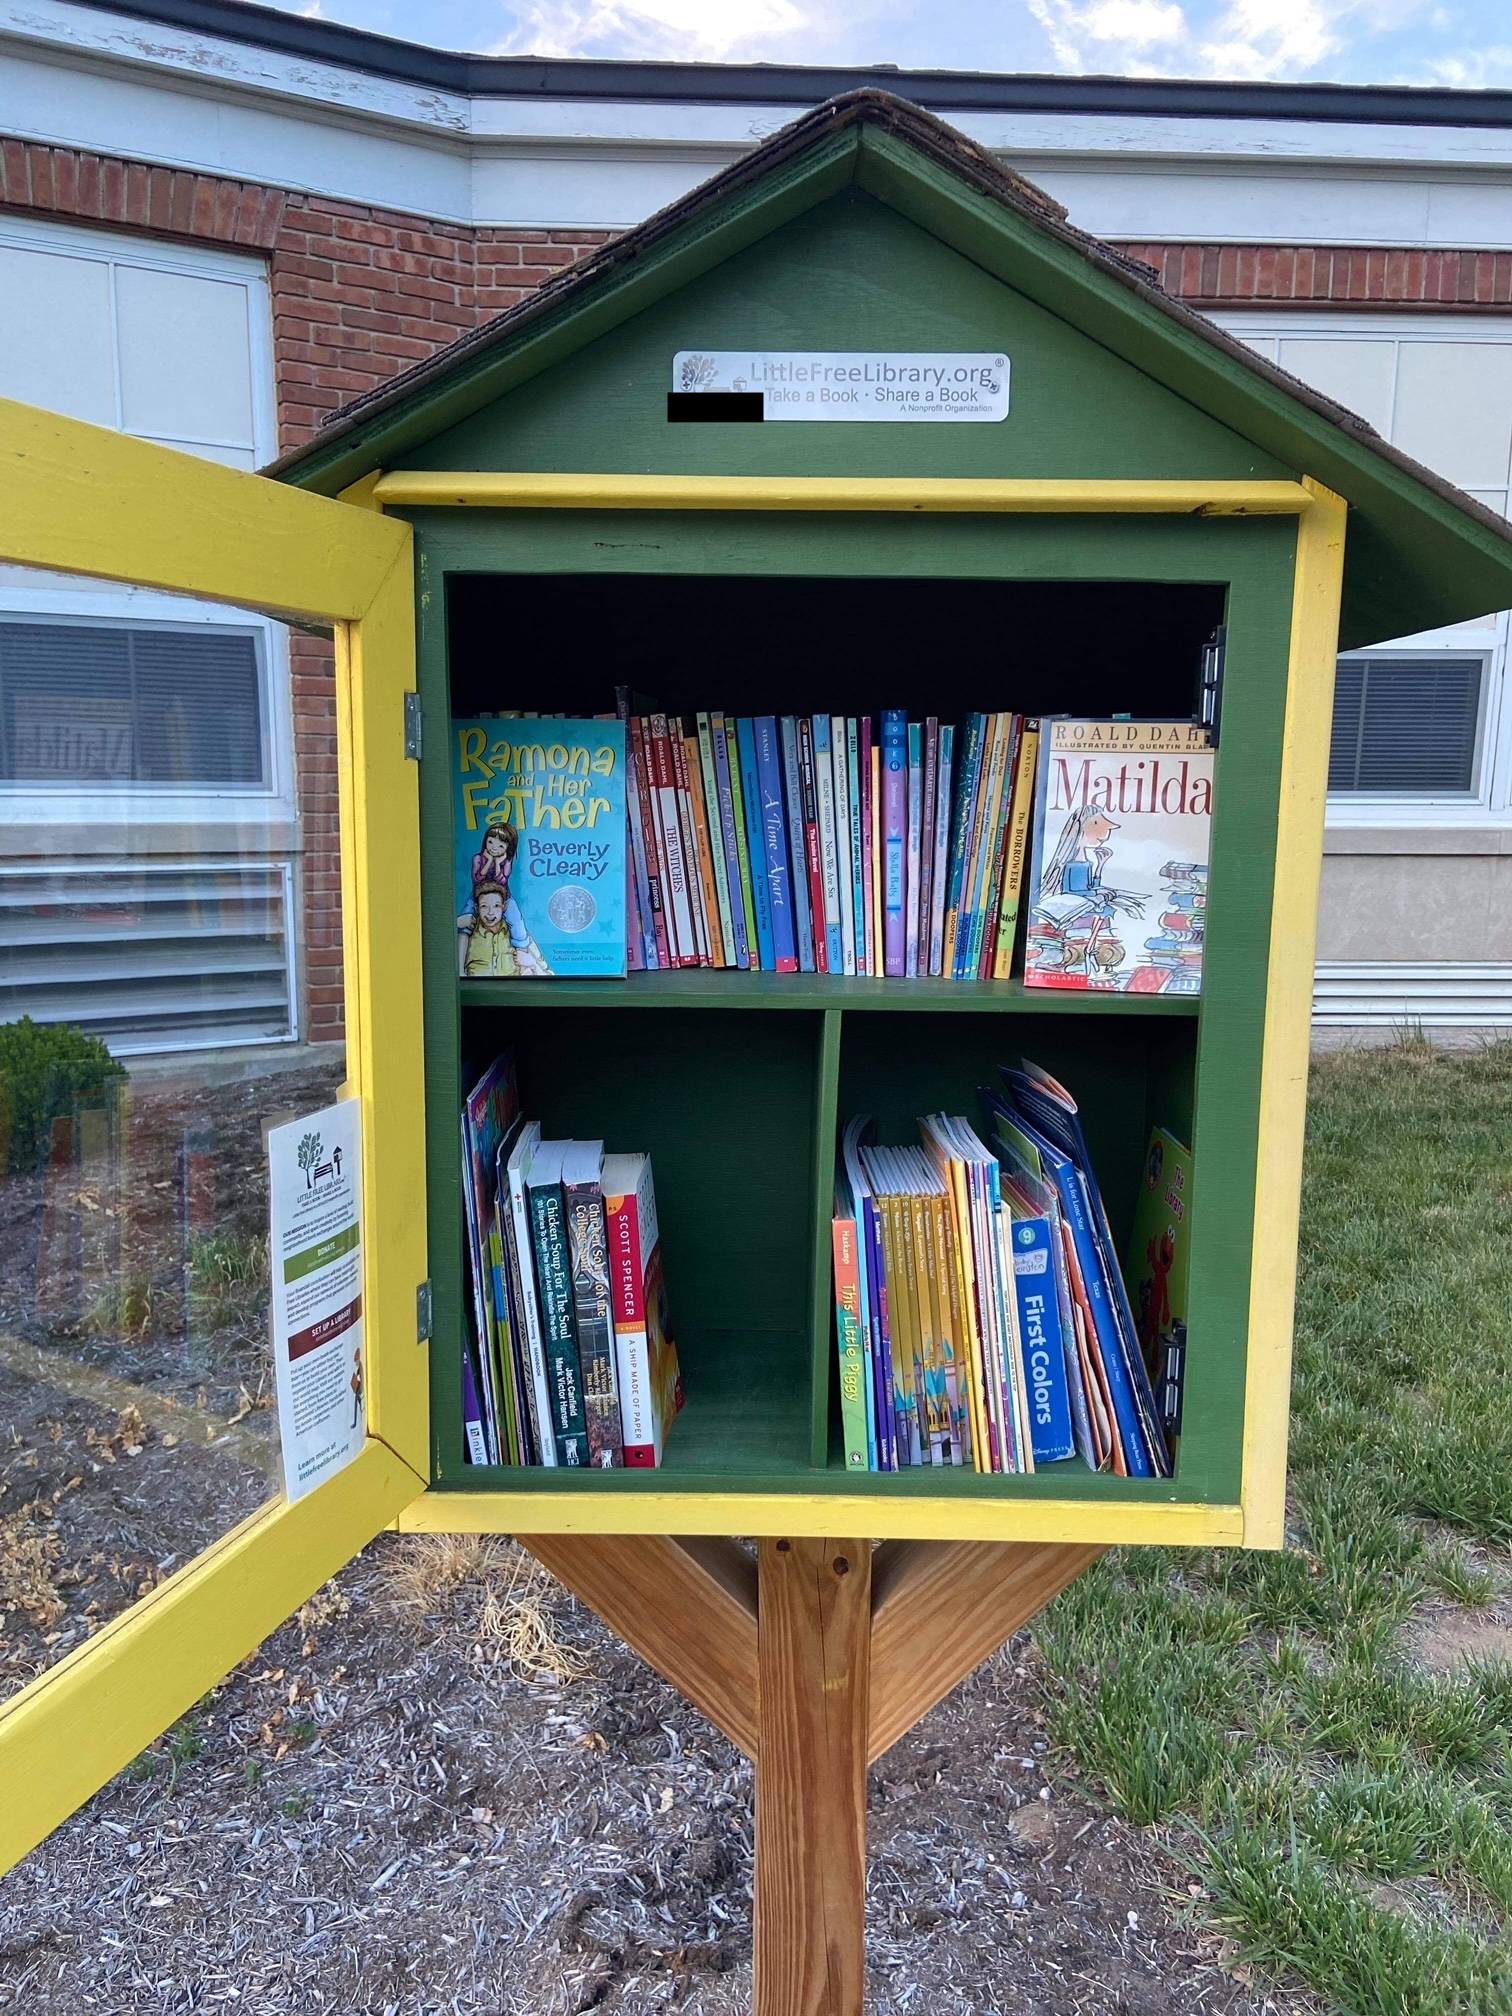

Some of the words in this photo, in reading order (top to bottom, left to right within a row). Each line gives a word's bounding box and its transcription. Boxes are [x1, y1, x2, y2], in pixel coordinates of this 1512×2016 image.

[751, 362, 993, 387] LittleFreeLibrary.org
[765, 388, 800, 403] Take
[806, 391, 815, 403] a
[820, 388, 859, 403] Book
[874, 387, 919, 402] Share
[925, 391, 934, 402] a
[939, 387, 978, 402] Book
[908, 404, 943, 413] Nonprofit
[945, 404, 993, 413] Organization
[1056, 726, 1138, 741] ROALD
[1150, 727, 1199, 742] DAH
[458, 727, 616, 779] Ramona
[643, 743, 652, 766] ROALD
[656, 739, 665, 764] ROALD
[671, 742, 680, 766] ROALD
[678, 745, 687, 768] ROALD
[715, 733, 725, 760] ELLIS
[759, 728, 771, 763] STANLEY
[786, 743, 796, 760] Vera
[998, 737, 1007, 756] Looking
[788, 760, 797, 774] and
[981, 756, 989, 768] Last
[1022, 742, 1033, 779] NORTON
[646, 765, 654, 784] DAHL
[659, 764, 668, 784] DAHL
[674, 767, 683, 786] DAHL
[682, 768, 690, 787] DAHL
[789, 774, 797, 786] Bill
[836, 759, 845, 792] GATHERING
[980, 768, 988, 780] Luke
[508, 774, 534, 787] and
[548, 774, 592, 797] Her
[705, 778, 714, 795] Yang
[822, 777, 830, 799] MILNE
[1049, 758, 1212, 817] Matilda
[720, 785, 735, 829] Pick-Up
[765, 789, 779, 809] A
[790, 785, 799, 810] Cleaver
[838, 793, 845, 803] OF
[709, 805, 718, 829] Second
[823, 804, 832, 834] SHEPARD
[838, 803, 846, 819] DAYS
[851, 803, 859, 817] TRUE
[1015, 810, 1026, 826] The
[664, 824, 678, 845] THE
[712, 829, 720, 841] and
[767, 813, 782, 850] Time
[791, 816, 803, 842] Queen
[808, 828, 816, 840] The
[851, 817, 859, 834] TALES
[713, 841, 721, 855] Her
[725, 829, 739, 863] Sticks
[793, 842, 803, 853] of
[809, 839, 817, 855] Junior
[824, 840, 833, 857] Now
[852, 834, 859, 842] OF
[684, 843, 697, 883] MARVELOUS
[794, 852, 805, 874] Hearts
[810, 855, 819, 873] Novel
[825, 857, 834, 870] We
[852, 842, 860, 864] ANIMAL
[888, 851, 899, 874] Stella
[1008, 827, 1024, 890] BORROWERS
[667, 846, 684, 893] WITCHES
[715, 855, 724, 875] Secret
[853, 864, 861, 885] HEROES
[755, 880, 765, 897] Time
[767, 856, 785, 906] Apart
[826, 871, 835, 885] Are
[888, 875, 899, 898] Batts
[649, 880, 660, 909] princess
[690, 883, 702, 918] MEDICINE
[717, 875, 727, 904] Admirers
[826, 885, 836, 899] Six
[757, 897, 766, 905] to
[758, 905, 767, 917] Fly
[722, 919, 732, 948] Namioka
[760, 916, 769, 931] Free
[973, 928, 981, 954] DOOPERS
[885, 957, 901, 965] SBP
[1034, 973, 1087, 983] SCHOLASTIC
[1067, 1181, 1076, 1189] is
[1175, 1164, 1185, 1191] The
[297, 1190, 313, 1204] LITTLE
[312, 1186, 323, 1197] FREE
[1068, 1187, 1079, 1200] for
[1164, 1184, 1185, 1222] Library
[1071, 1198, 1083, 1217] Lone
[545, 1196, 561, 1242] Chicken
[573, 1204, 590, 1244] College
[586, 1202, 604, 1248] Chicken
[1075, 1215, 1086, 1232] Star
[619, 1215, 631, 1254] SCOTT
[1022, 1230, 1032, 1243] 9
[317, 1241, 336, 1257] DONATE
[548, 1241, 564, 1270] Soup
[839, 1229, 852, 1265] Haskamp
[591, 1248, 605, 1277] Soup
[1016, 1262, 1045, 1273] einstein
[553, 1271, 565, 1290] For
[594, 1280, 606, 1299] for
[622, 1259, 635, 1316] SPENCER
[1091, 1278, 1103, 1299] Texas
[555, 1290, 569, 1313] The
[595, 1298, 608, 1318] the
[840, 1283, 857, 1311] This
[311, 1324, 322, 1337] SET
[322, 1320, 331, 1332] UP
[334, 1307, 352, 1324] LIBRARY
[557, 1313, 572, 1340] Soul
[1025, 1295, 1048, 1348] First
[842, 1315, 859, 1358] Little
[553, 1356, 566, 1377] Mark
[628, 1347, 637, 1368] SHIP
[564, 1366, 575, 1386] Jack
[629, 1370, 639, 1395] MADE
[843, 1362, 861, 1403] Piggy
[555, 1376, 568, 1401] Victor
[1031, 1351, 1053, 1425] Colors
[565, 1384, 579, 1417] Canfield
[631, 1396, 640, 1409] OF
[557, 1400, 571, 1430] Hansen
[632, 1411, 642, 1439] PAPER
[298, 1456, 315, 1471] Learn
[315, 1447, 330, 1461] more
[330, 1441, 337, 1451] at
[298, 1443, 349, 1482] littlefreelibrary.org
